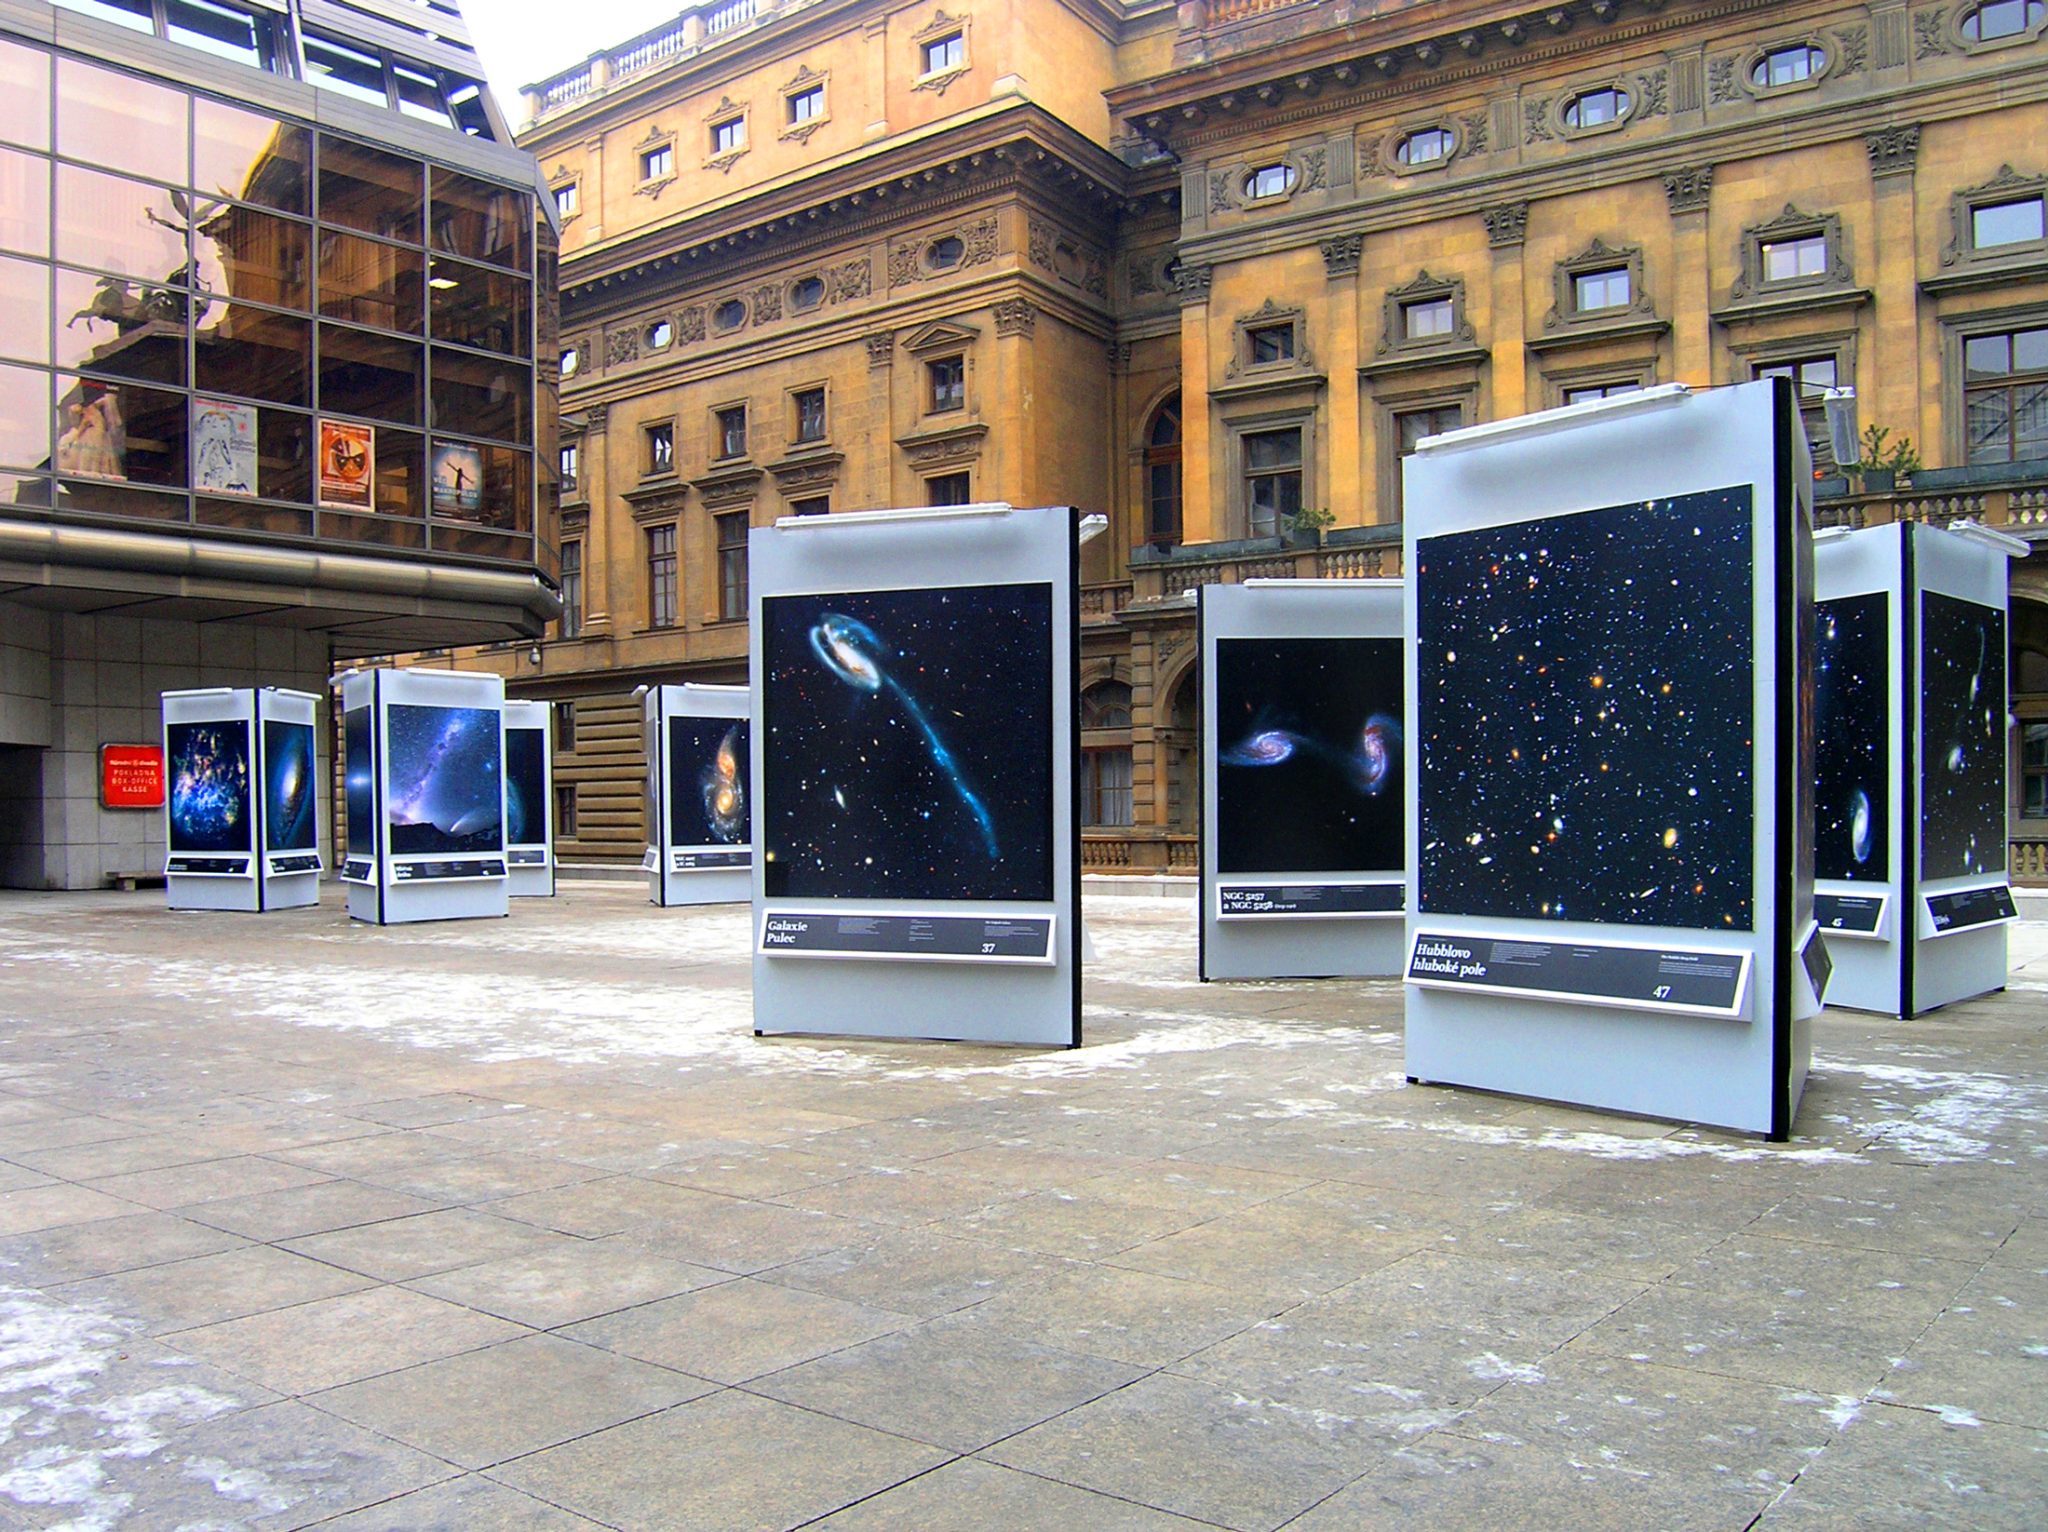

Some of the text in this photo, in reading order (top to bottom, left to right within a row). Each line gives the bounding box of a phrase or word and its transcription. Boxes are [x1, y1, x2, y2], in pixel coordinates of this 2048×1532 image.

[1223, 892, 1244, 900] NGC
[767, 920, 808, 932] Galaxie
[766, 933, 796, 943] Pulec
[981, 943, 996, 953] 37
[1416, 943, 1471, 959] Hubblovo
[1412, 957, 1487, 978] hluboké pole
[1652, 985, 1671, 999] 47
